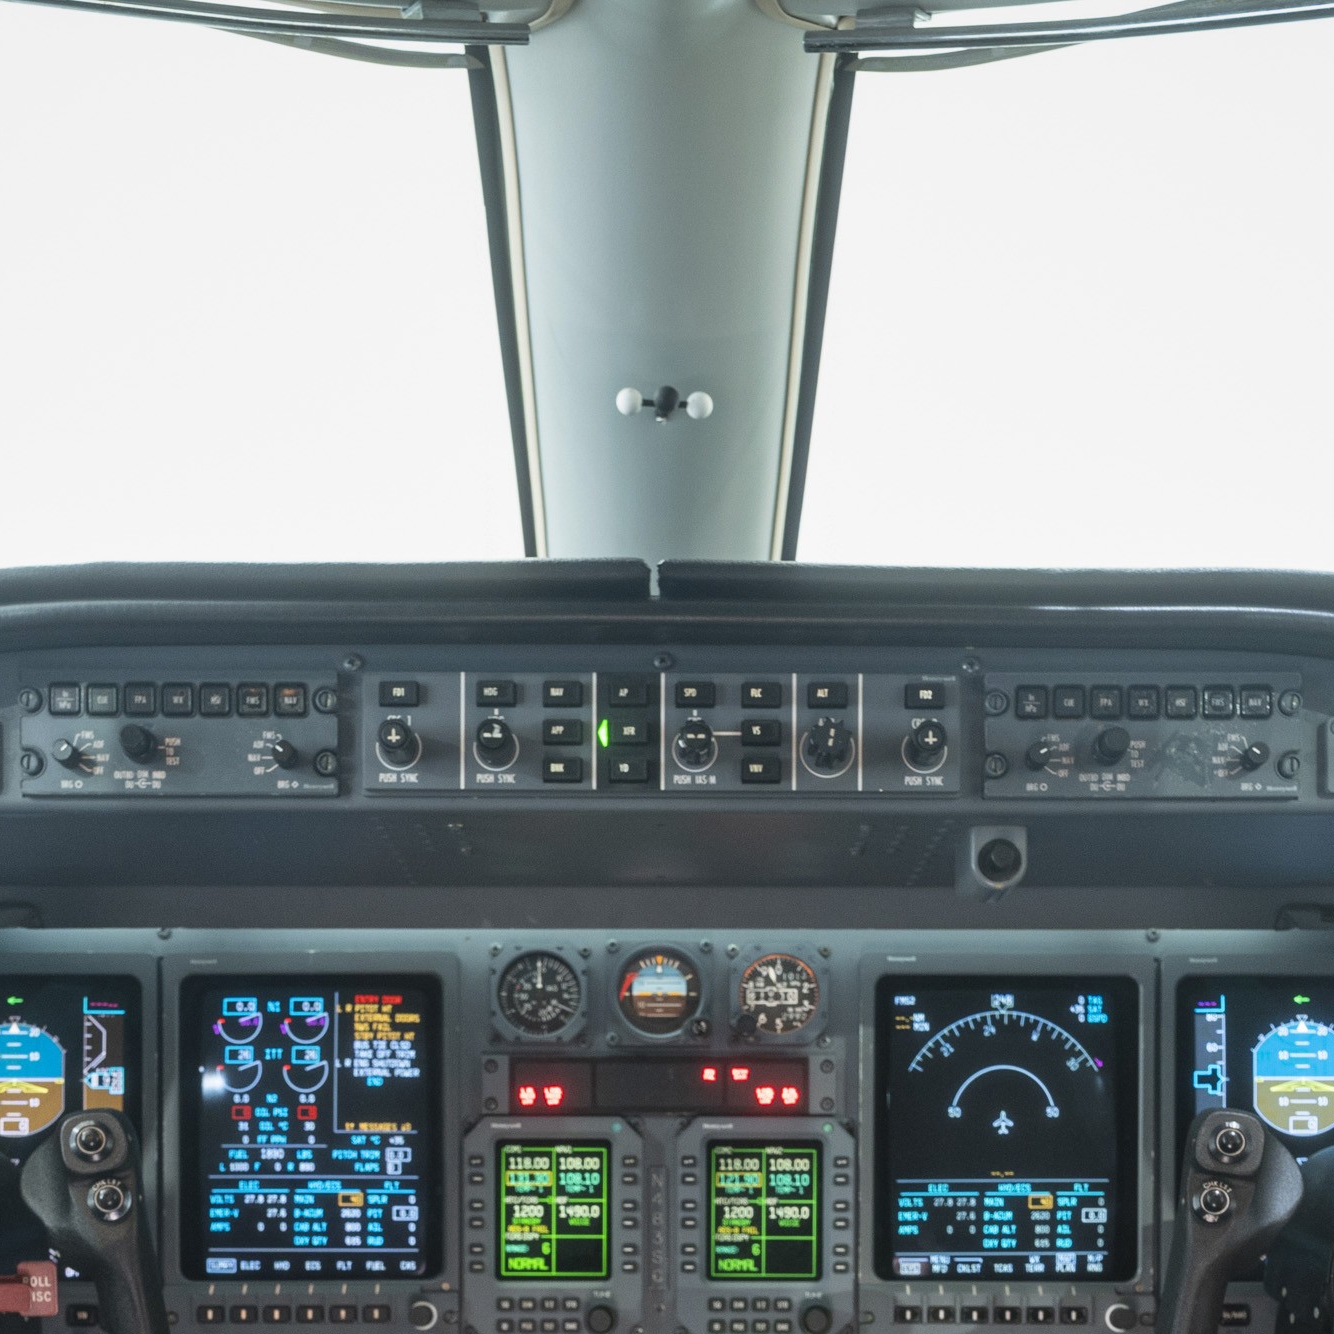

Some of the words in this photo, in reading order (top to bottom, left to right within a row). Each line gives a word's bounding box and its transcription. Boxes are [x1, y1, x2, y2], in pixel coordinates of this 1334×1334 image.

[508, 1157, 549, 1170] 118.00
[559, 1157, 600, 1170] 108.00
[719, 1158, 759, 1171] 118.00
[769, 1158, 810, 1171] 108.00
[513, 1205, 544, 1218] 1200
[559, 1205, 600, 1218] 1490.0
[723, 1206, 754, 1219] 1200
[769, 1206, 810, 1219] 1490.0
